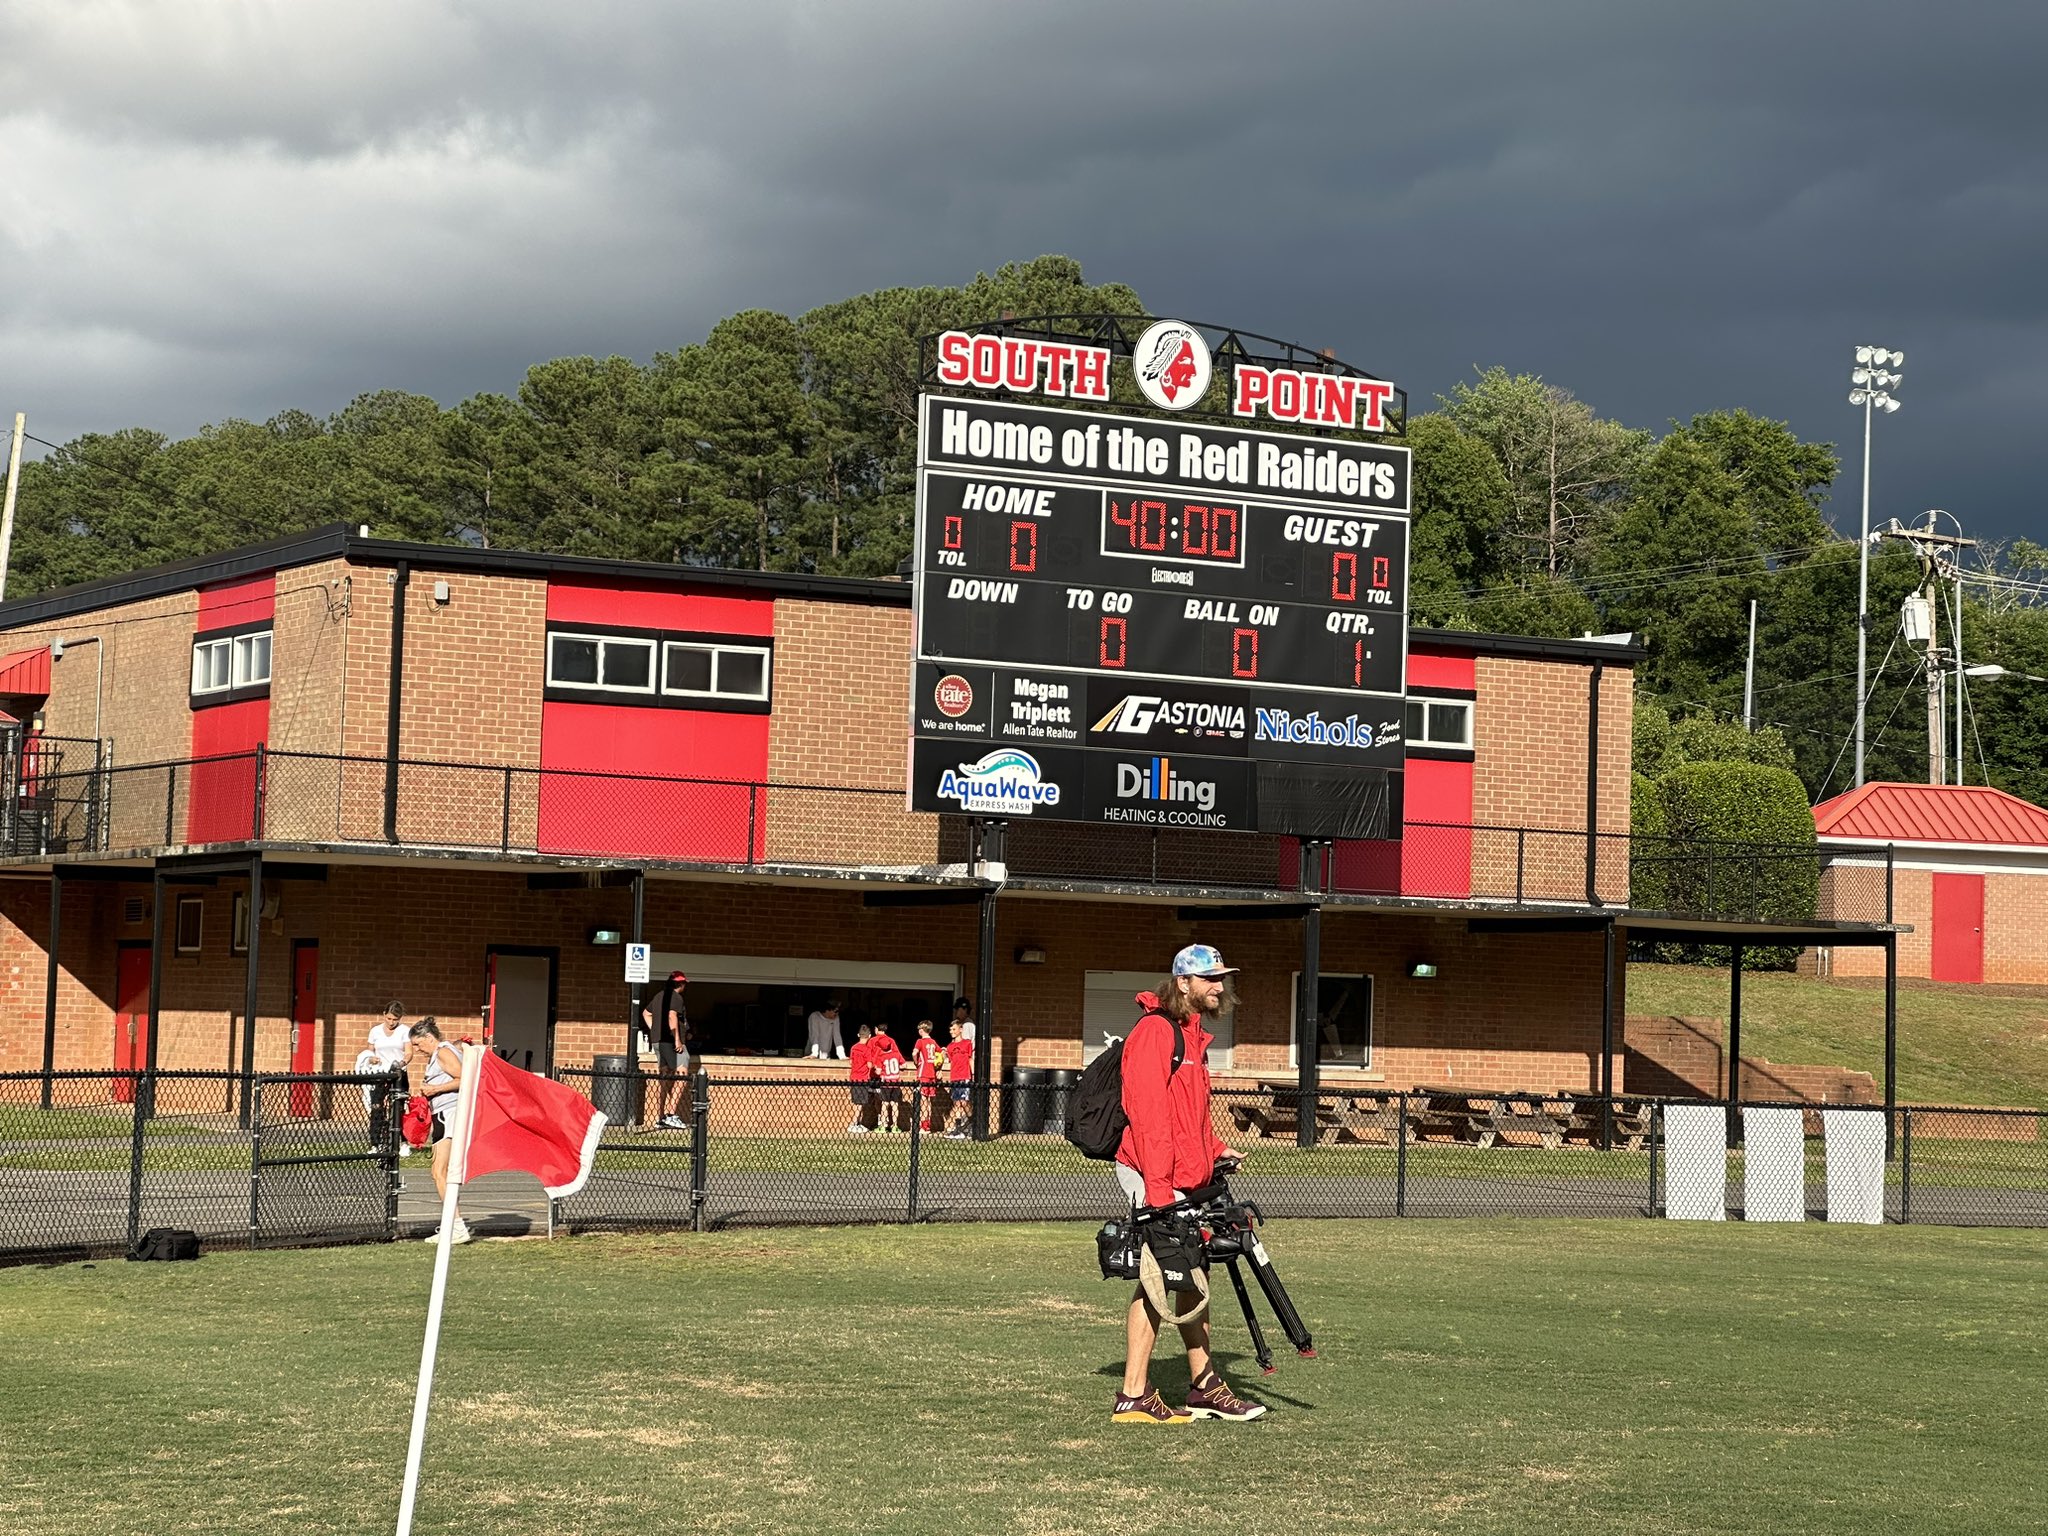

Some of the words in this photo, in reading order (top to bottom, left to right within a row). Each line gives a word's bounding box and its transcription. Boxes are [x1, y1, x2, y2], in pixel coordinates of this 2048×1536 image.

[938, 330, 1110, 401] SOUTH
[1234, 363, 1394, 431] POINT
[942, 408, 1053, 464] Home
[1062, 424, 1100, 468] of
[1107, 427, 1169, 475] the
[1179, 433, 1249, 484] Red
[1257, 442, 1395, 500] Raiders
[961, 483, 1056, 517] HOME
[944, 516, 962, 548] 0
[1111, 500, 1237, 558] 40:00
[1283, 514, 1380, 548] GUEST
[937, 550, 967, 566] TOL
[1010, 520, 1037, 572] 0
[1332, 552, 1357, 600] 0
[1373, 557, 1389, 587] 0
[947, 578, 1018, 603] DOWN
[1066, 588, 1094, 610] TO
[1101, 592, 1133, 613] GO
[1367, 589, 1393, 604] TOL
[1184, 599, 1240, 623] BALL
[1248, 604, 1280, 626] ON
[1326, 611, 1375, 634] QTR.
[1100, 617, 1127, 667] 0
[1232, 628, 1258, 678] 0
[940, 684, 969, 703] tate
[1014, 678, 1069, 702] Megan
[921, 719, 937, 729] We
[938, 722, 953, 730] are
[1010, 701, 1071, 725] Triplett
[1115, 695, 1246, 734] GASTONIA
[1002, 722, 1025, 736] Allen
[1026, 724, 1044, 737] Tate
[1046, 726, 1077, 739] Realtor
[1206, 729, 1225, 737] GMC
[1255, 707, 1373, 748] Nichols
[1375, 733, 1400, 747] Stores
[1379, 719, 1400, 735] Food
[940, 773, 1057, 806] AquaWave
[1117, 757, 1216, 811] Dilling
[970, 799, 1006, 810] EXPRESS
[1008, 802, 1030, 811] WASH
[1104, 807, 1156, 823] HEATING
[1157, 810, 1167, 823] &
[1168, 811, 1227, 827] COOLING
[883, 1057, 900, 1075] 10
